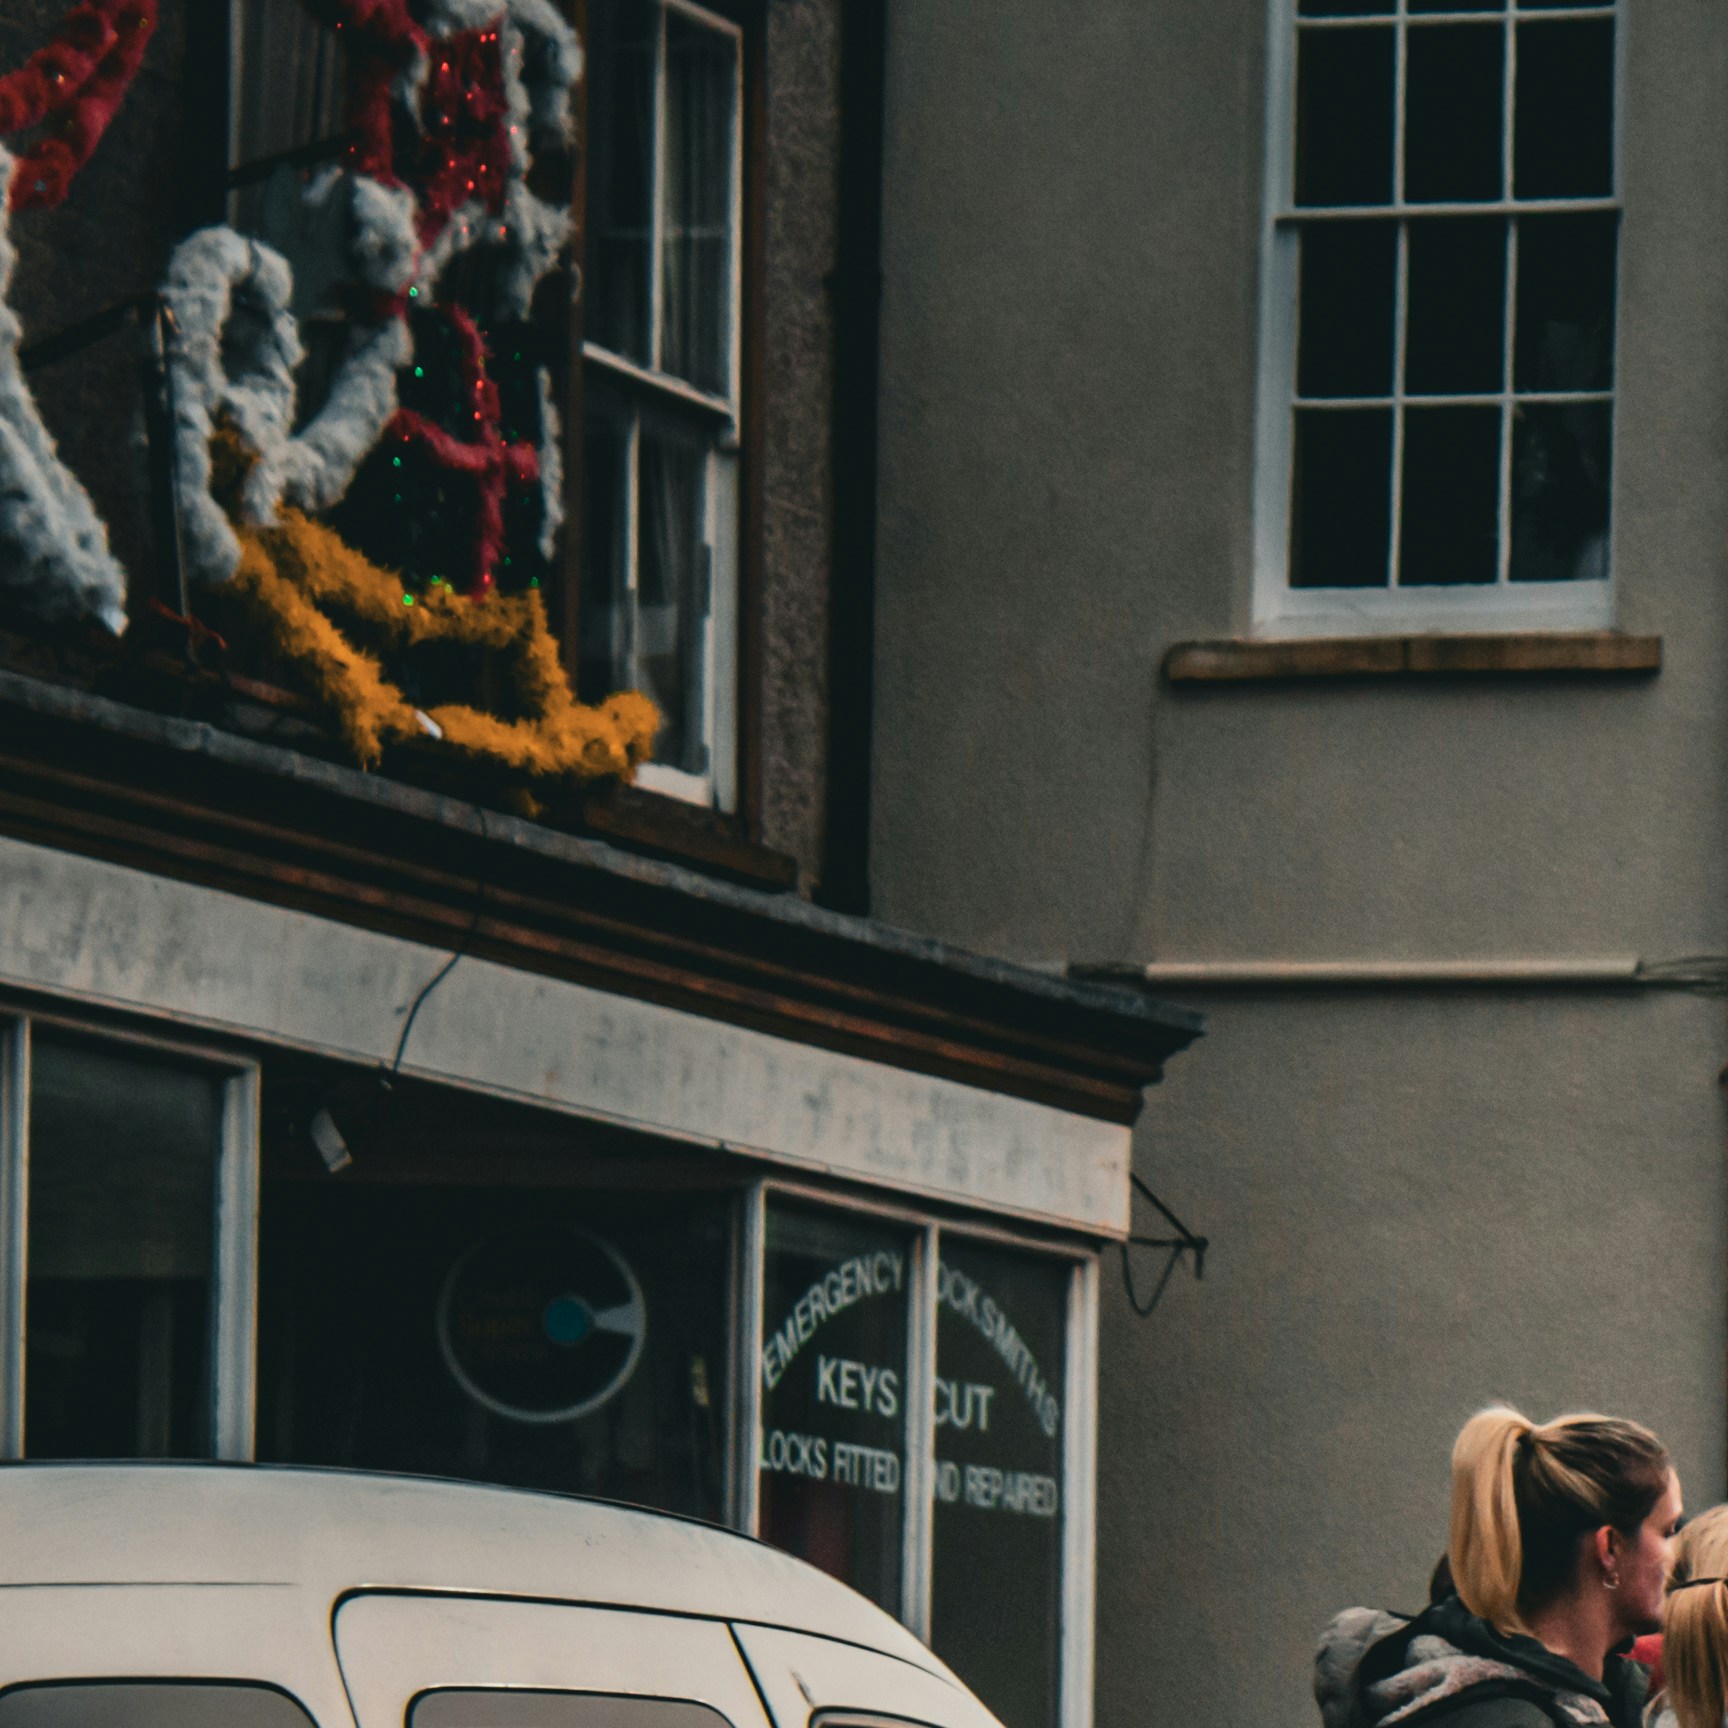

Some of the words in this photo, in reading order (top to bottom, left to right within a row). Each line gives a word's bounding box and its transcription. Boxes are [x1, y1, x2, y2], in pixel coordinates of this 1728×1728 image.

[762, 1250, 903, 1391] EMERGENCY
[939, 1262, 1059, 1438] OCKSMITHS
[817, 1354, 899, 1418] KEYS
[933, 1376, 994, 1432] CUT
[759, 1429, 827, 1480] LOCKS
[833, 1441, 900, 1495] FITTED
[933, 1460, 960, 1503] ND
[964, 1464, 1058, 1518] REPAIRED
